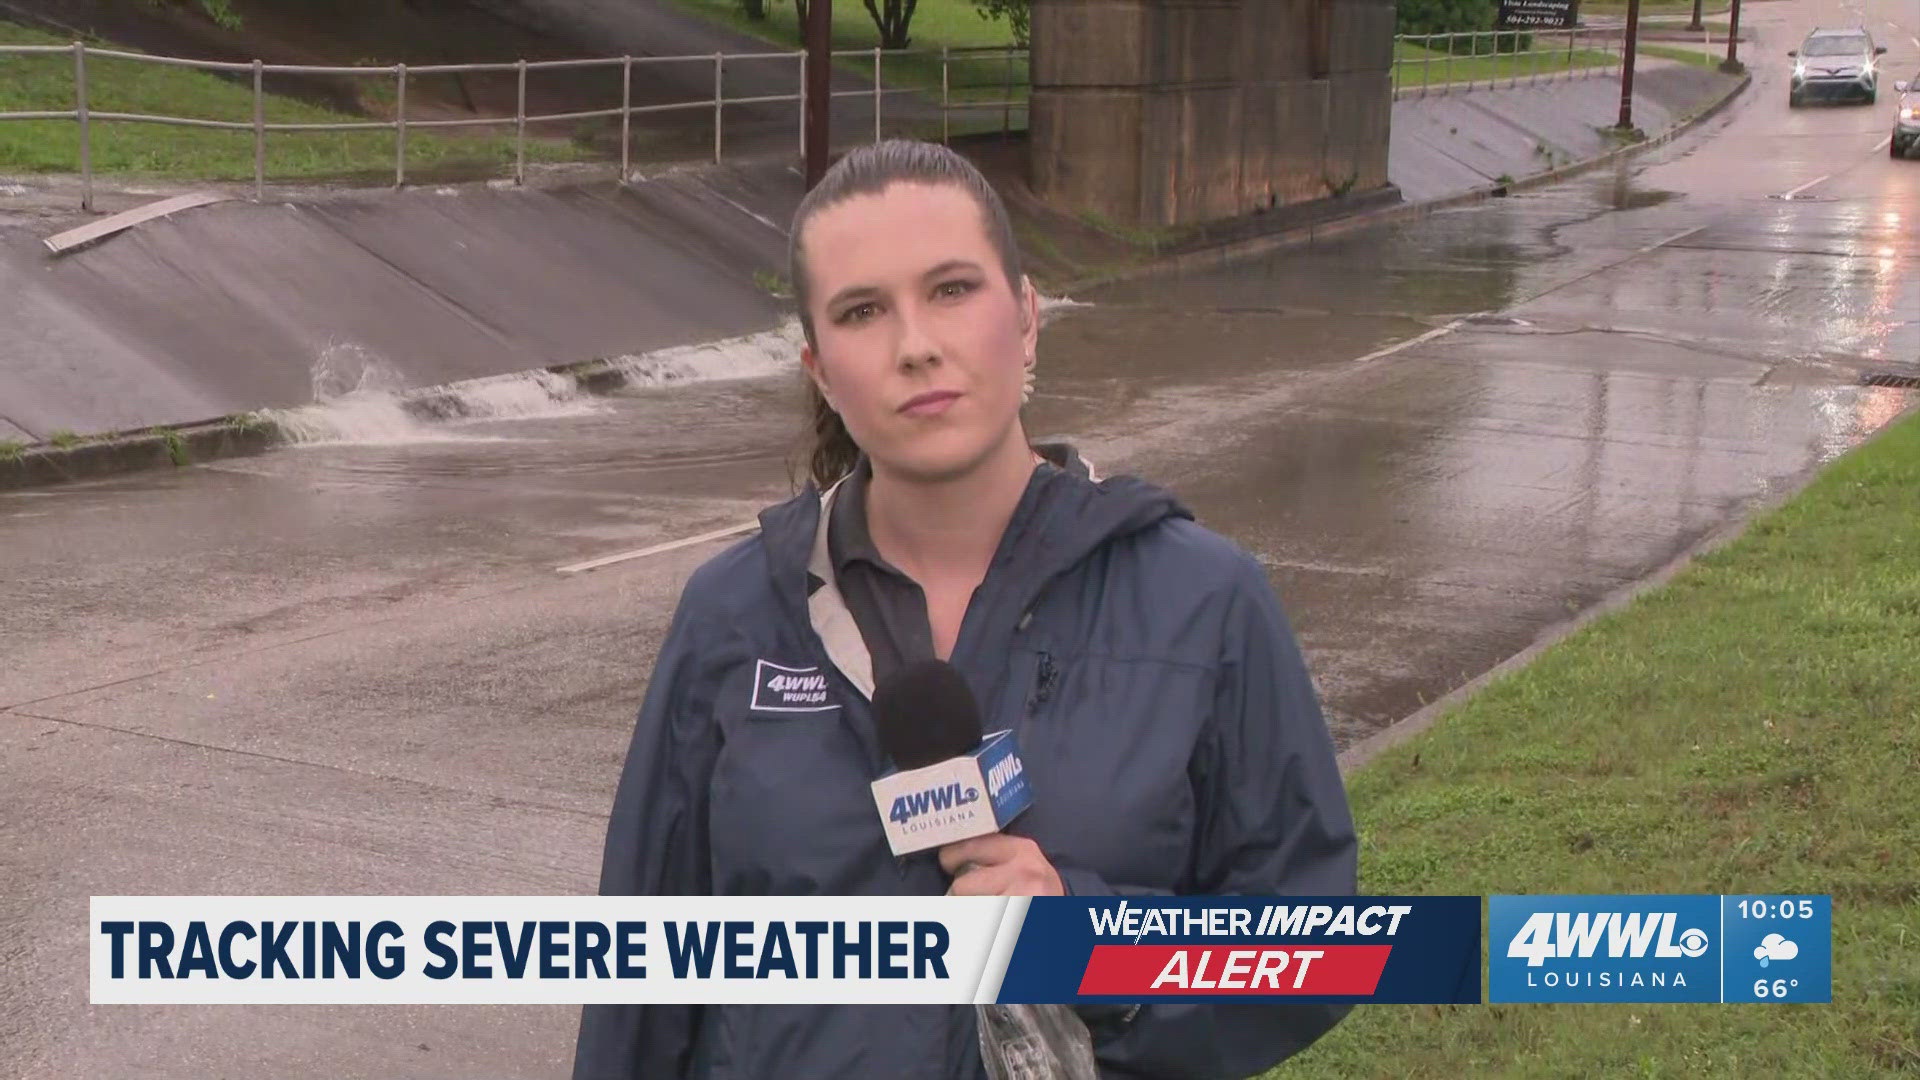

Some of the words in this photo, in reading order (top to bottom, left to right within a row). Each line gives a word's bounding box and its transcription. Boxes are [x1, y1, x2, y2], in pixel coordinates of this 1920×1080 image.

[767, 675, 827, 692] 4WWL
[889, 782, 967, 824] 4WWL
[902, 810, 975, 835] LOUISIANA
